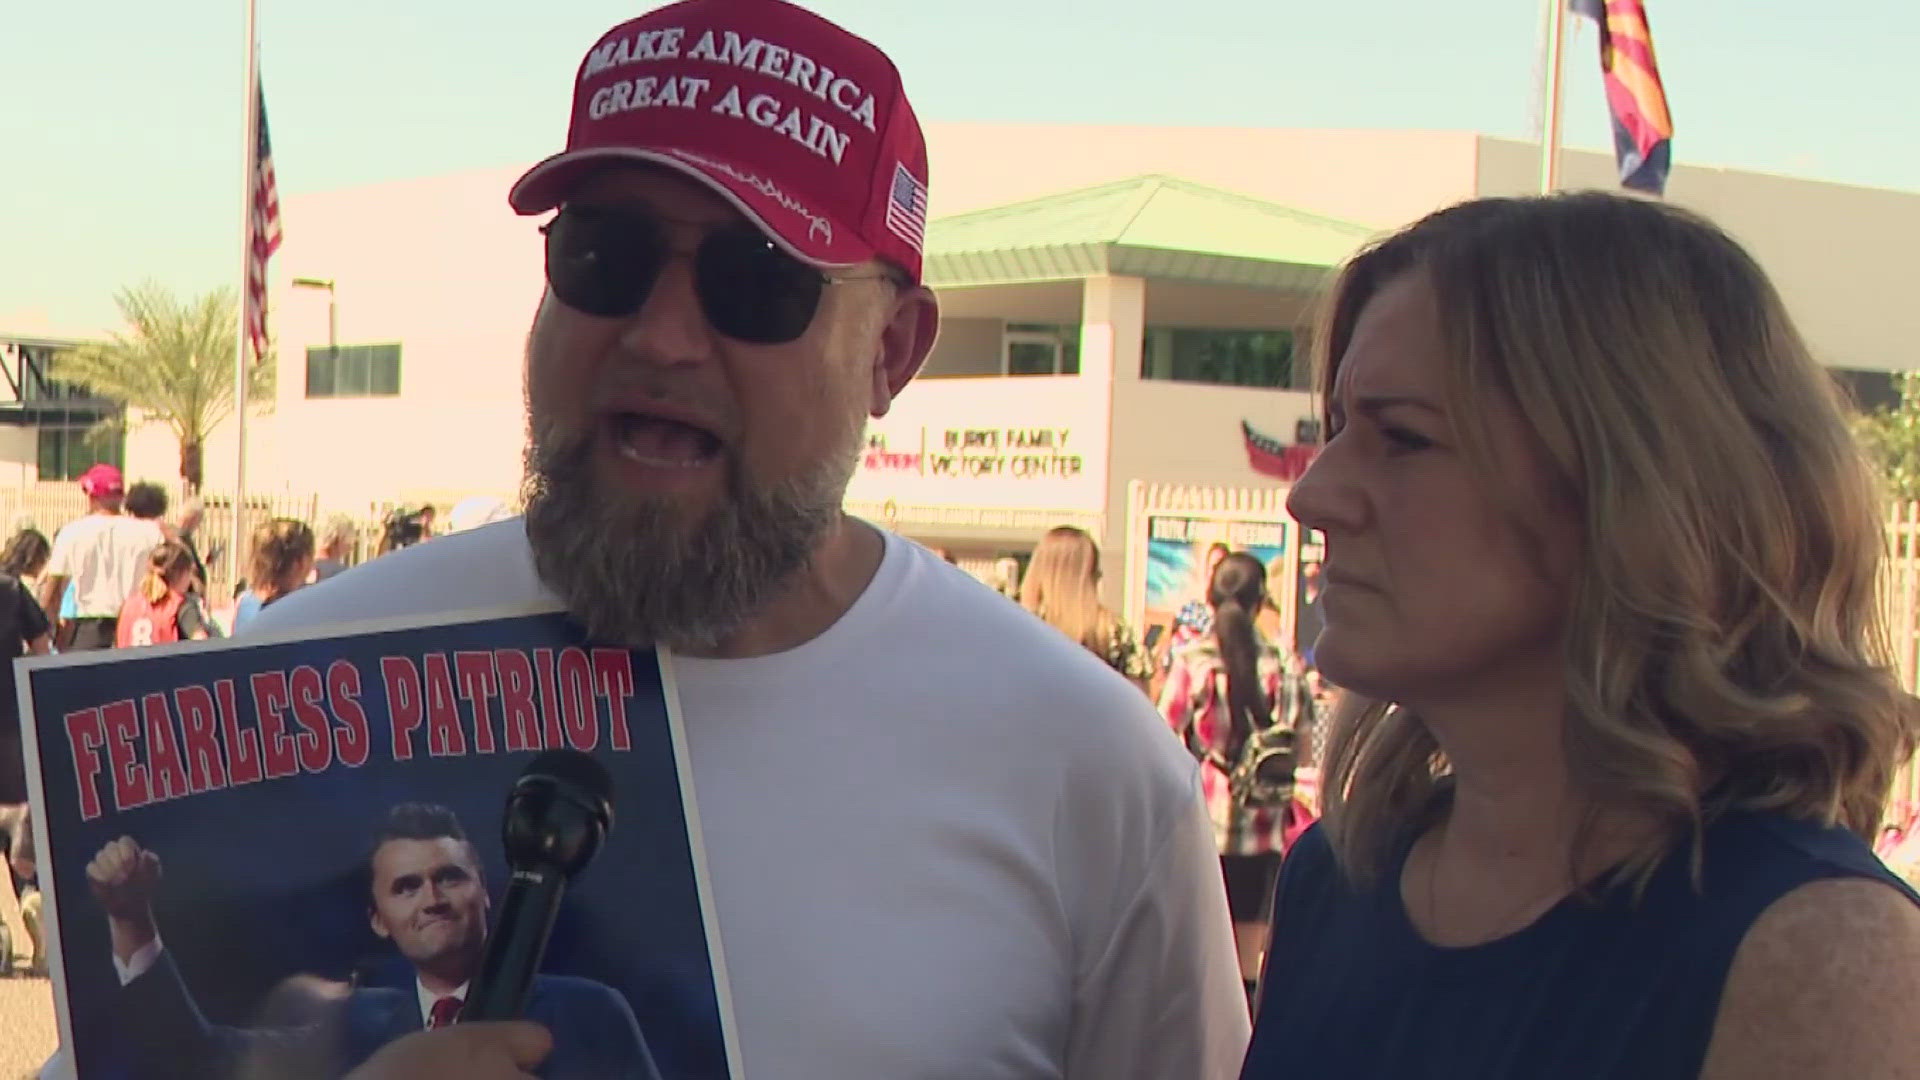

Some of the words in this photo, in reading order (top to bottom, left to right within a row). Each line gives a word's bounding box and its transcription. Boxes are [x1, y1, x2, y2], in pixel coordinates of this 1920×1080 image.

[584, 27, 685, 78] MAKE
[689, 29, 876, 133] AMERICA
[590, 77, 709, 120] GREAT
[713, 85, 850, 166] AGAIN
[930, 454, 1004, 477] VICTORY
[1011, 455, 1083, 478] CENTER
[1006, 429, 1069, 449] FAMILY
[64, 660, 369, 821] FEARLESS
[380, 647, 634, 760] PATRIOT
